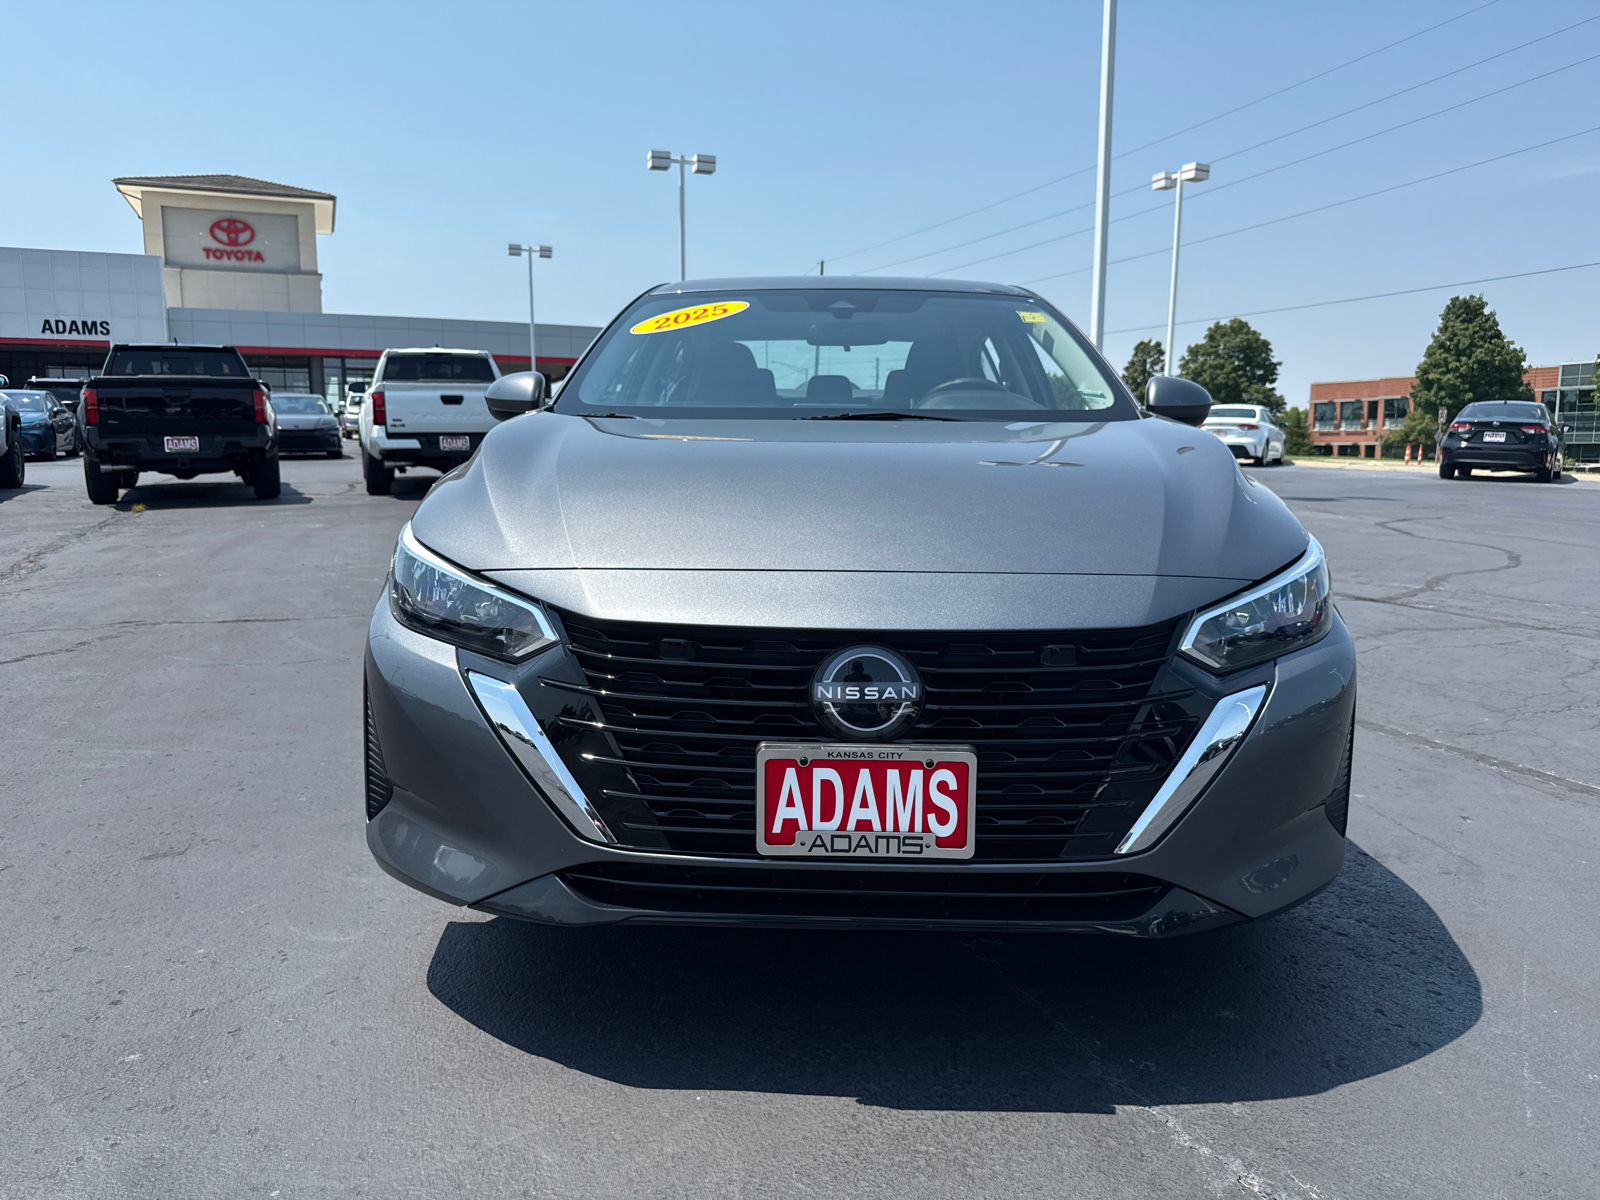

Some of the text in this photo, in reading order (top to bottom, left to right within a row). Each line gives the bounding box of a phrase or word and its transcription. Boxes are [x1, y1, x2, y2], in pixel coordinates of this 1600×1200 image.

[202, 248, 265, 263] TOYOTA
[654, 303, 729, 331] 2025
[41, 319, 111, 336] ADAMS
[168, 438, 197, 450] ADAMS
[443, 437, 468, 449] ADAMS
[817, 685, 917, 700] NISSAN
[827, 751, 904, 760] KANSAS CITY
[771, 767, 959, 838] ADAMS
[807, 834, 924, 855] ADAMS
